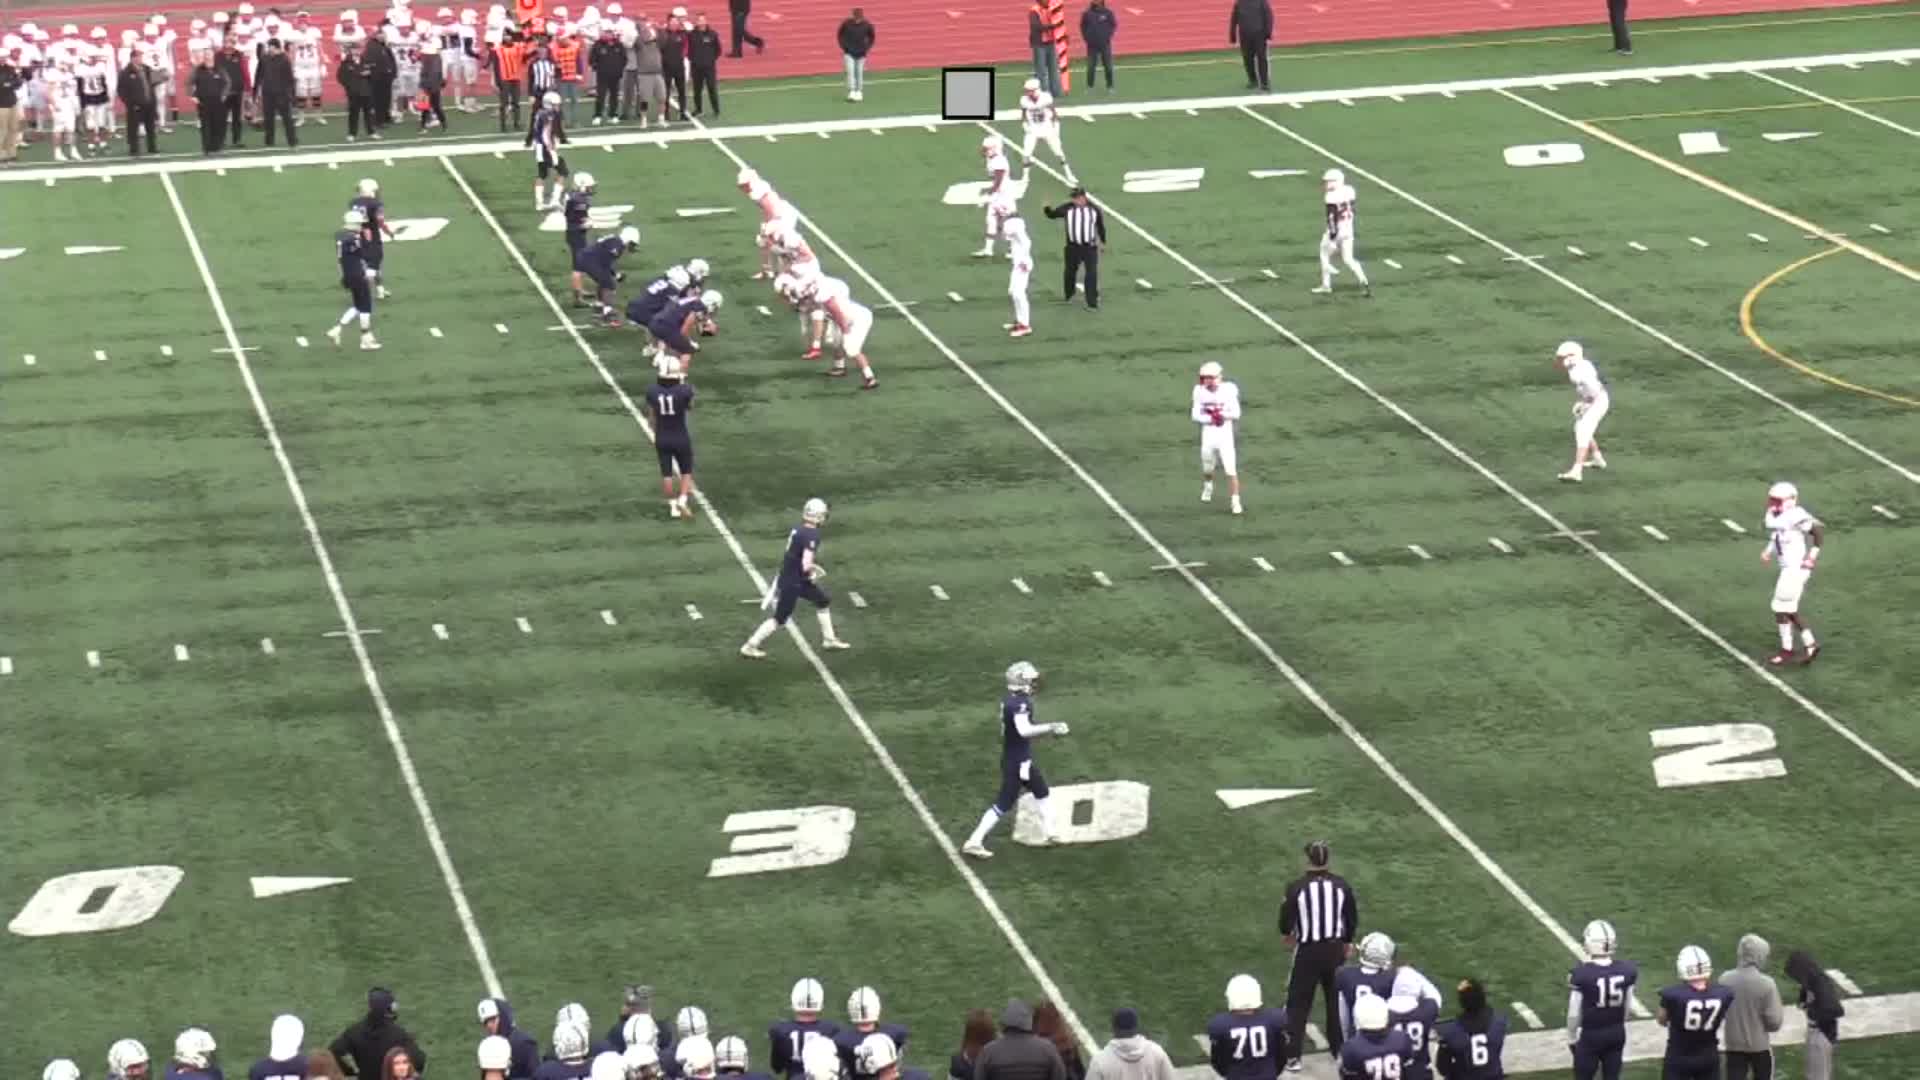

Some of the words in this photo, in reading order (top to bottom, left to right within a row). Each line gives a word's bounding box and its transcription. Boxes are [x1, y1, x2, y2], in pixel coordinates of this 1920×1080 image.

[657, 394, 676, 416] 11
[8, 865, 185, 937] 0
[1595, 974, 1625, 1010] 15
[1683, 997, 1724, 1031] 67
[1229, 1025, 1269, 1060] 70
[1469, 1032, 1489, 1066] 6
